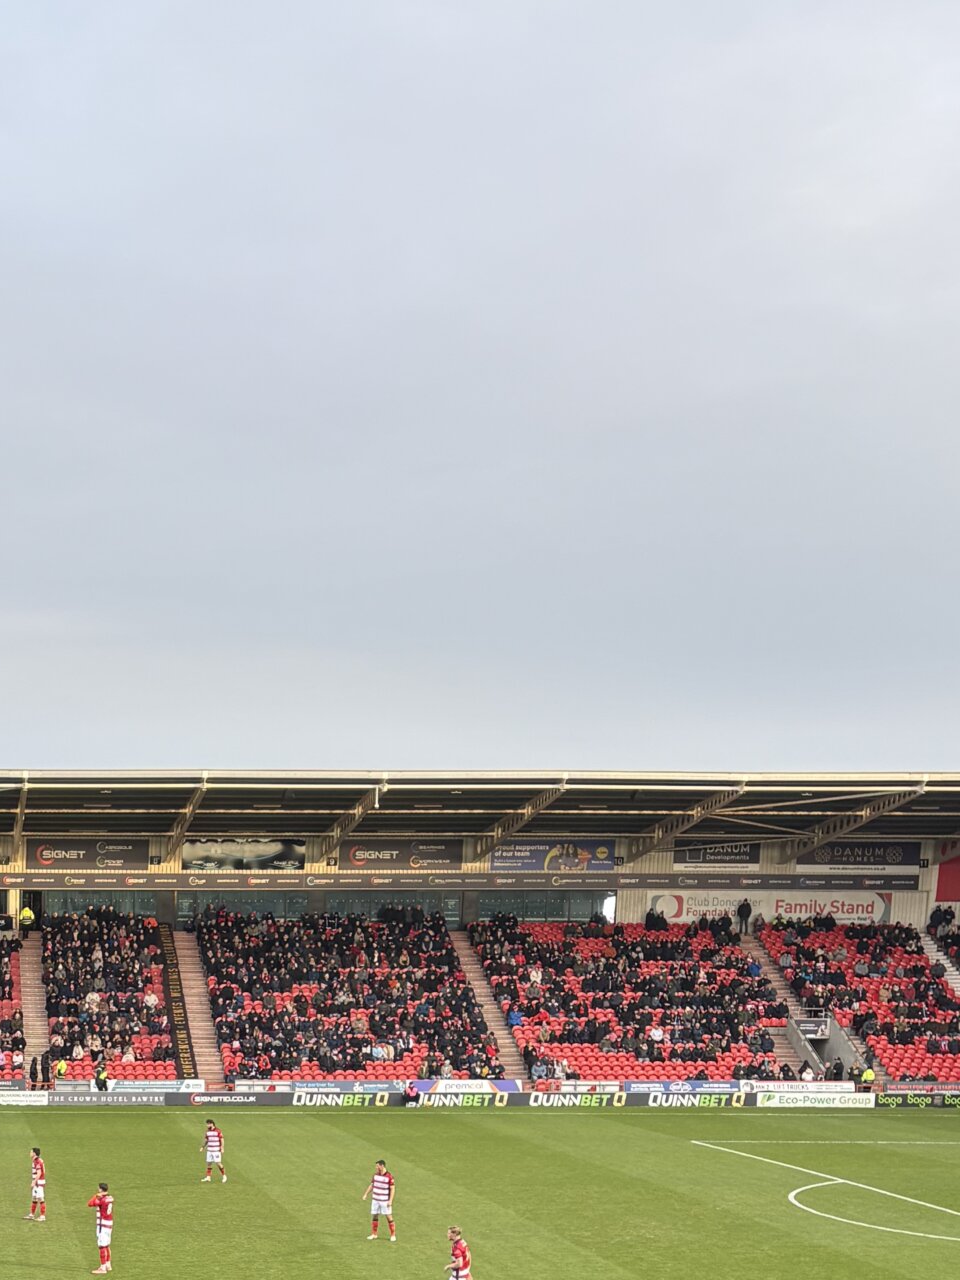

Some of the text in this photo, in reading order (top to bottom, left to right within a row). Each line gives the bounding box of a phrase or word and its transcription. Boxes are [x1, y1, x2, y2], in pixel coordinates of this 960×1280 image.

[515, 844, 549, 853] supporters
[834, 847, 885, 856] DANUM
[42, 850, 86, 859] SIGNET
[355, 850, 399, 860] SIGNET
[706, 853, 750, 862] Developments
[614, 857, 622, 866] 10
[686, 897, 709, 907] Club
[686, 907, 737, 918] Foundatio
[775, 899, 875, 916] Family Stand
[176, 1029, 195, 1079] CONFERENCING
[787, 1083, 810, 1091] TRUCKS
[48, 1095, 164, 1103] THE CROWN HOTEL BAWTRY
[292, 1091, 373, 1107] QUINNBET
[529, 1091, 611, 1107] QUINNBET
[648, 1091, 730, 1107] QUINNBET
[778, 1095, 872, 1107] Eco-Power Group
[877, 1093, 903, 1108] Sage
[907, 1093, 932, 1108] Sage
